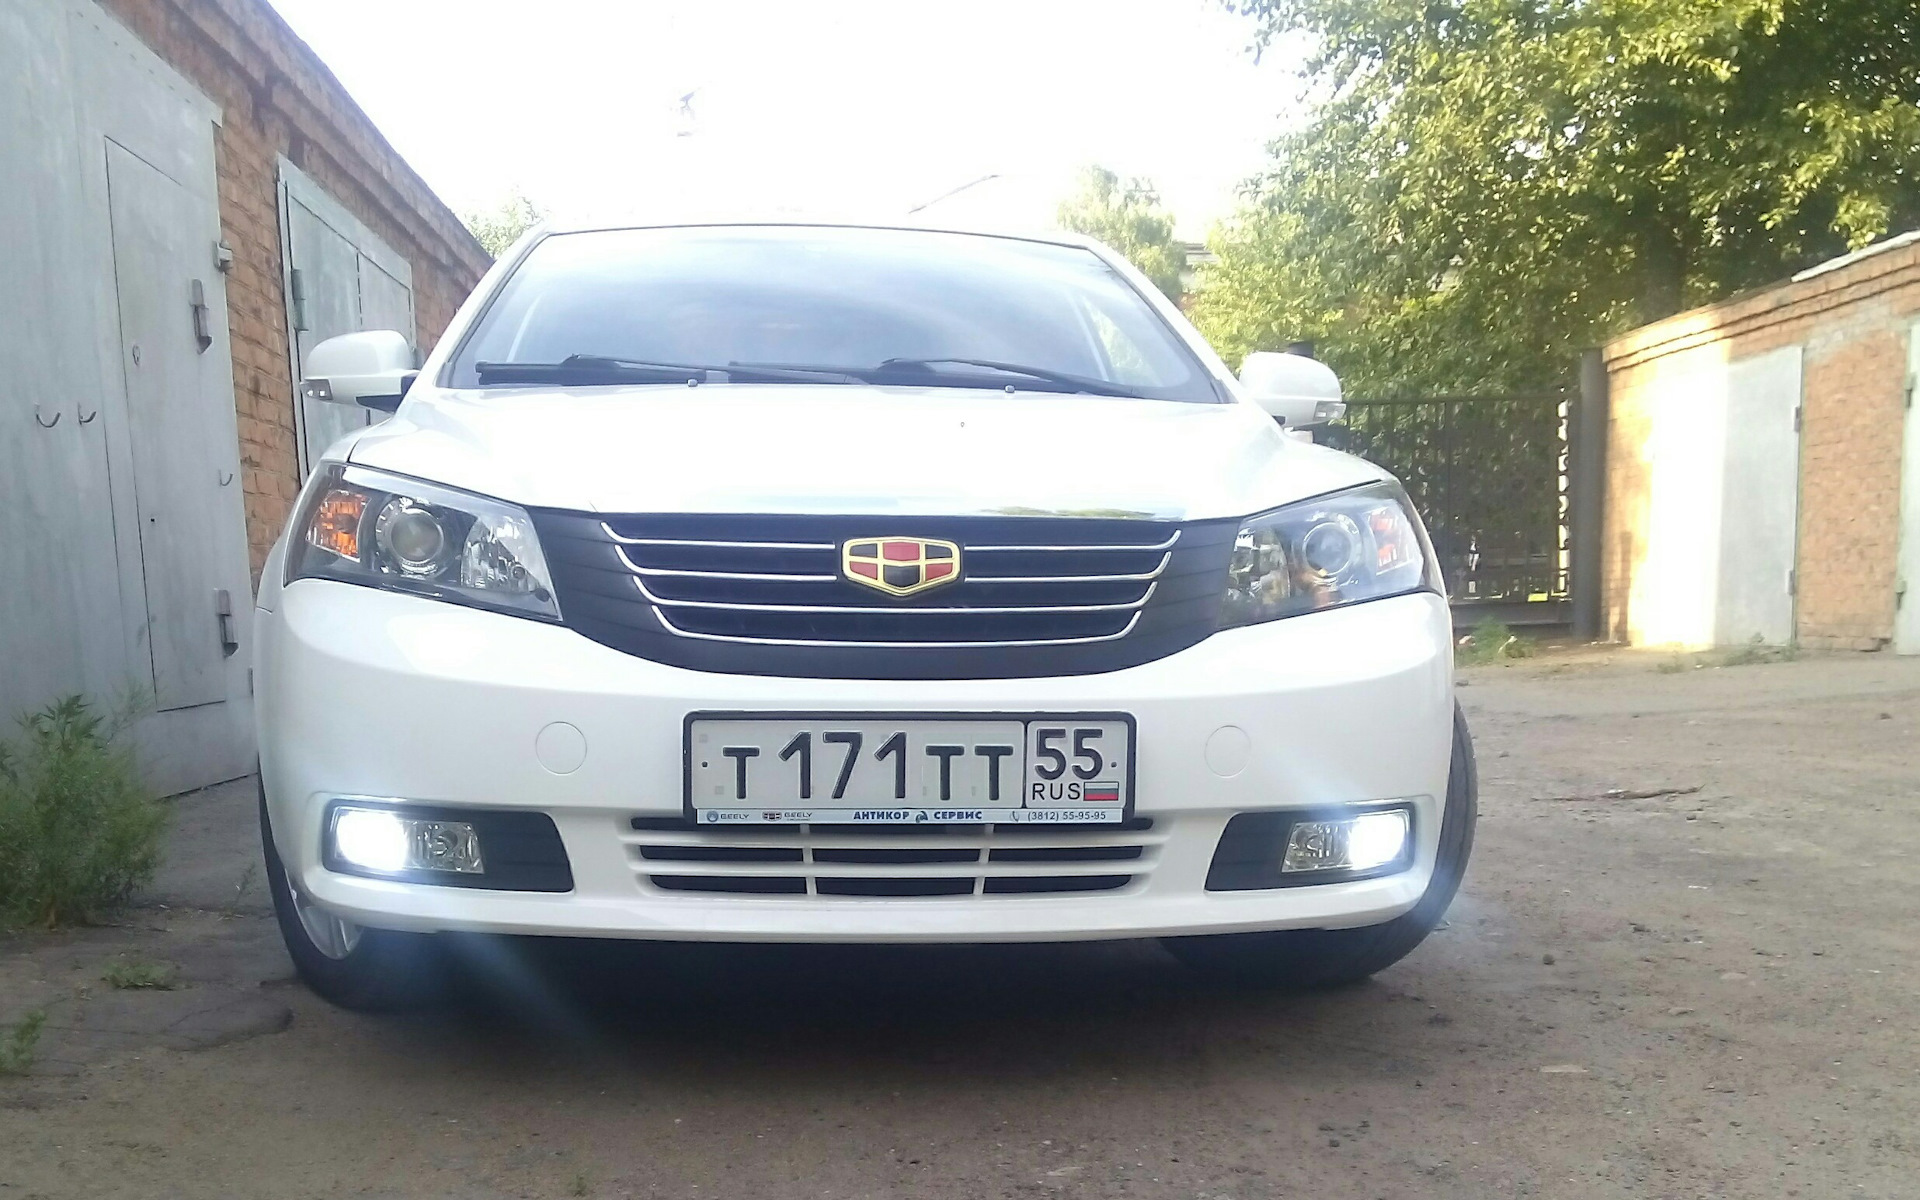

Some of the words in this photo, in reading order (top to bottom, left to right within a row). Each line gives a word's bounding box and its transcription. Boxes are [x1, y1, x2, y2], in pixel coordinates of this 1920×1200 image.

[1034, 728, 1104, 780] 55
[1031, 782, 1082, 801] RUS
[853, 811, 910, 820] АНТИКОР
[933, 811, 983, 820] СЕРВИС
[1027, 810, 1060, 821] (3812)
[1062, 811, 1107, 820] 55-95-95
